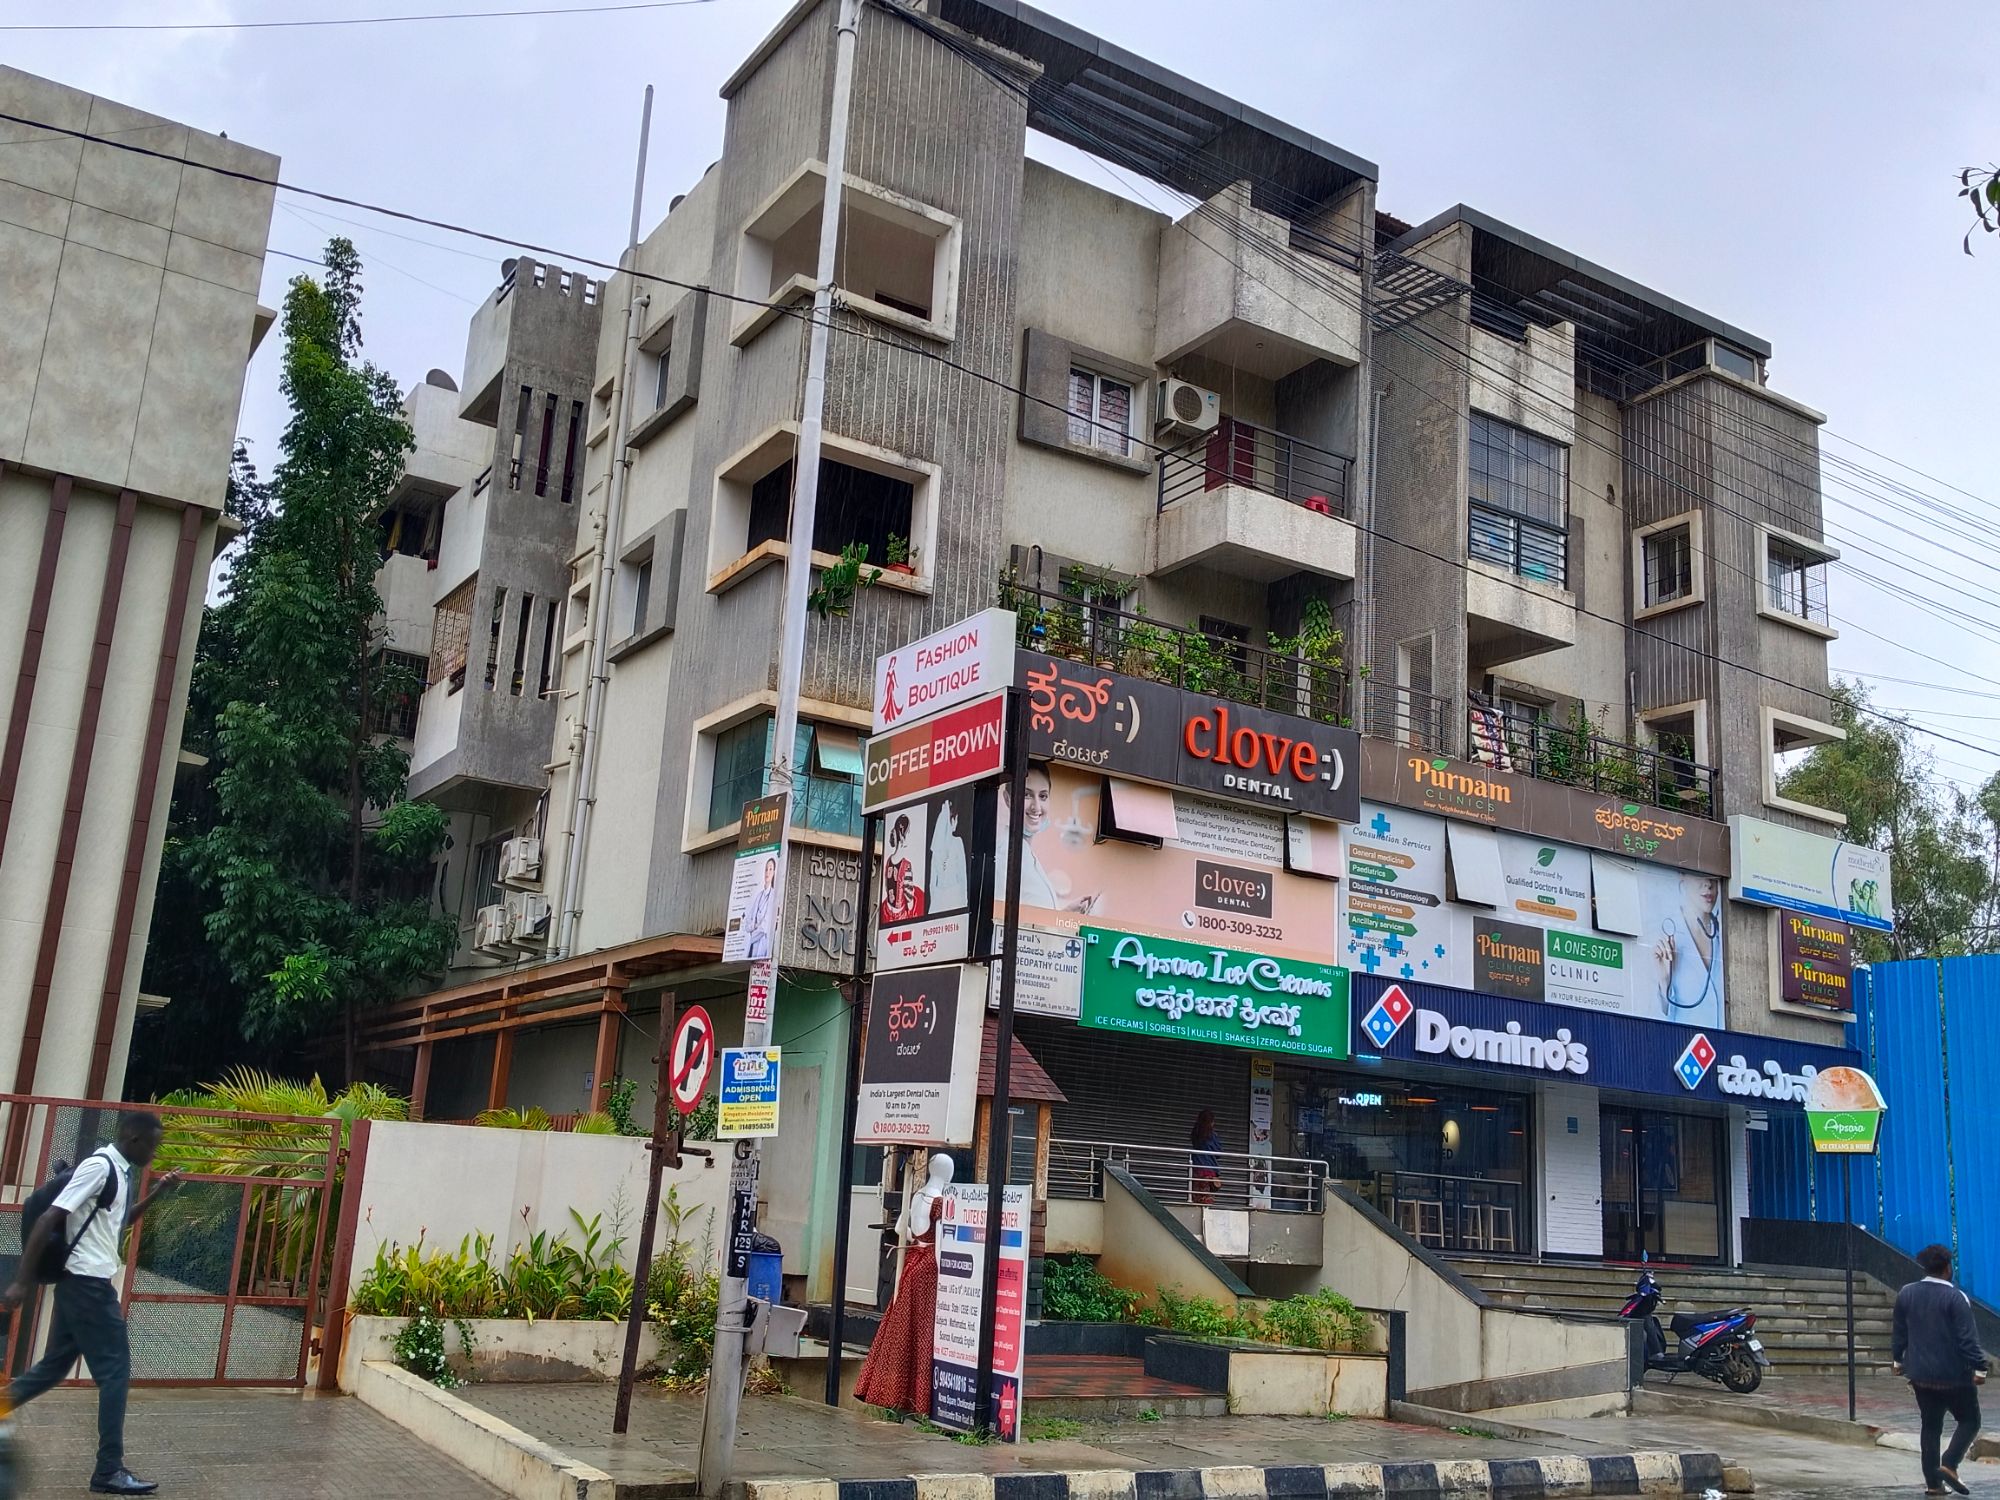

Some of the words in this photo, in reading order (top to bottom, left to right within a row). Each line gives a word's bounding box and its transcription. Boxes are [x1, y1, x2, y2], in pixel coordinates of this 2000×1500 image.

[916, 629, 979, 672] FASHION
[907, 662, 980, 707] BOUTIQUE
[867, 743, 931, 786] COFFEE
[933, 719, 1000, 765] BROWN
[1223, 774, 1294, 801] DENTAL
[1425, 789, 1495, 812] CLINICS
[1208, 822, 1231, 833] Surgery
[1402, 837, 1431, 851] Services
[1352, 847, 1377, 859] General
[1377, 854, 1405, 865] medicine
[1352, 864, 1386, 877] Paediatrics
[1352, 881, 1383, 895] Obstetrics
[1384, 888, 1390, 896] &
[1390, 889, 1429, 905] Gynaecology
[1506, 875, 1533, 888] Qualified
[1534, 881, 1558, 893] Doctors
[1559, 887, 1563, 895] &
[1564, 887, 1586, 899] Nurses
[1217, 896, 1251, 908] DENTAL
[1351, 898, 1377, 910] Daycare
[1377, 904, 1403, 914] services
[1198, 914, 1283, 941] 1800-309-3232
[1351, 915, 1379, 928] Ancillary
[1380, 921, 1405, 931] services
[1553, 937, 1561, 952] A
[1564, 940, 1618, 961] ONE-STOP
[1054, 962, 1078, 974] CLINIC
[1488, 960, 1531, 975] CLINICS
[1550, 963, 1599, 983] CLINIC
[1559, 993, 1573, 1001] YOUR
[1575, 995, 1621, 1009] NEIGHBOURHOOD
[1095, 1015, 1108, 1025] ICE
[1110, 1017, 1144, 1030] CREAMS
[1150, 1022, 1186, 1036] SORBETS
[1191, 1027, 1218, 1040] KULFIS
[1225, 1032, 1256, 1045] SHAKES
[1260, 1037, 1280, 1048] ZERO
[1281, 1041, 1306, 1051] ADDED
[1307, 1044, 1333, 1054] SUGAR
[1415, 1008, 1589, 1075] Domino's
[724, 1085, 776, 1093] ADMISSIONS
[870, 1090, 886, 1098] India's
[886, 1090, 906, 1099] Largest
[906, 1089, 924, 1097] Dental
[924, 1089, 940, 1098] Chain
[911, 1103, 921, 1111] pm
[880, 1122, 930, 1135] 1800-309-3232
[1824, 1118, 1866, 1133] Apsara
